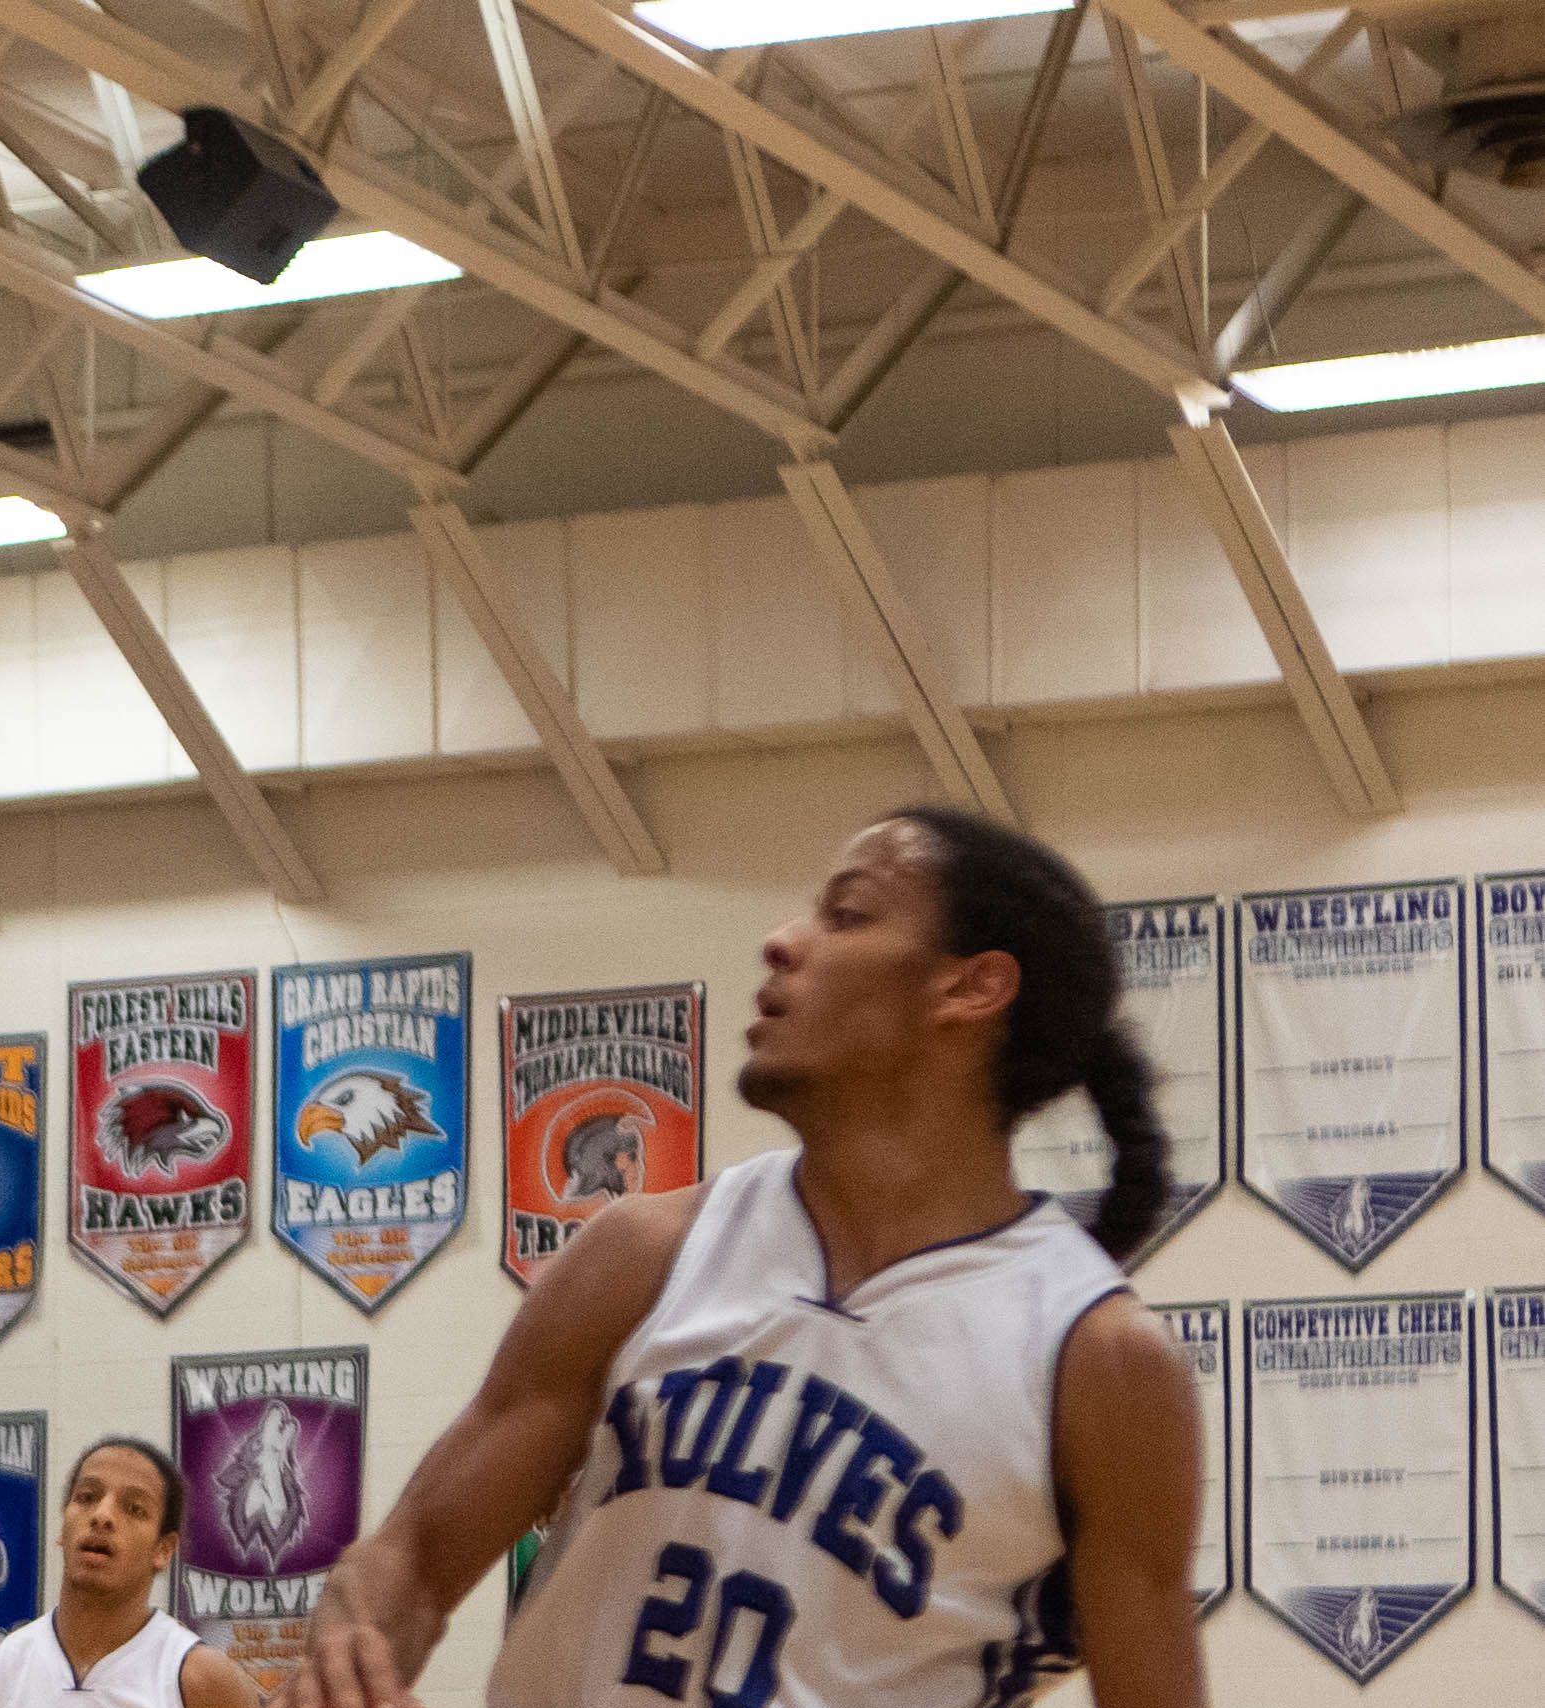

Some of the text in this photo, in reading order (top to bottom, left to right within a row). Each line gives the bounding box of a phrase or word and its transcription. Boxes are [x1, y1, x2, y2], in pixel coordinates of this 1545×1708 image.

[1251, 889, 1451, 931] WRESTLING
[79, 982, 246, 1042] FOREST HILLS
[284, 966, 460, 1029] GRAND RAPIDS
[108, 1026, 214, 1075] EASTERN
[305, 1014, 437, 1070] CHRISTIAN
[515, 997, 687, 1054] MIDDLEVILLE
[83, 1179, 247, 1231] HAWKS
[286, 1171, 457, 1223] EAGLES
[514, 1212, 583, 1255] TR
[1253, 1304, 1390, 1340] COMPETITIVE
[1398, 1301, 1463, 1335] CHEER
[186, 1359, 355, 1412] WYOMING
